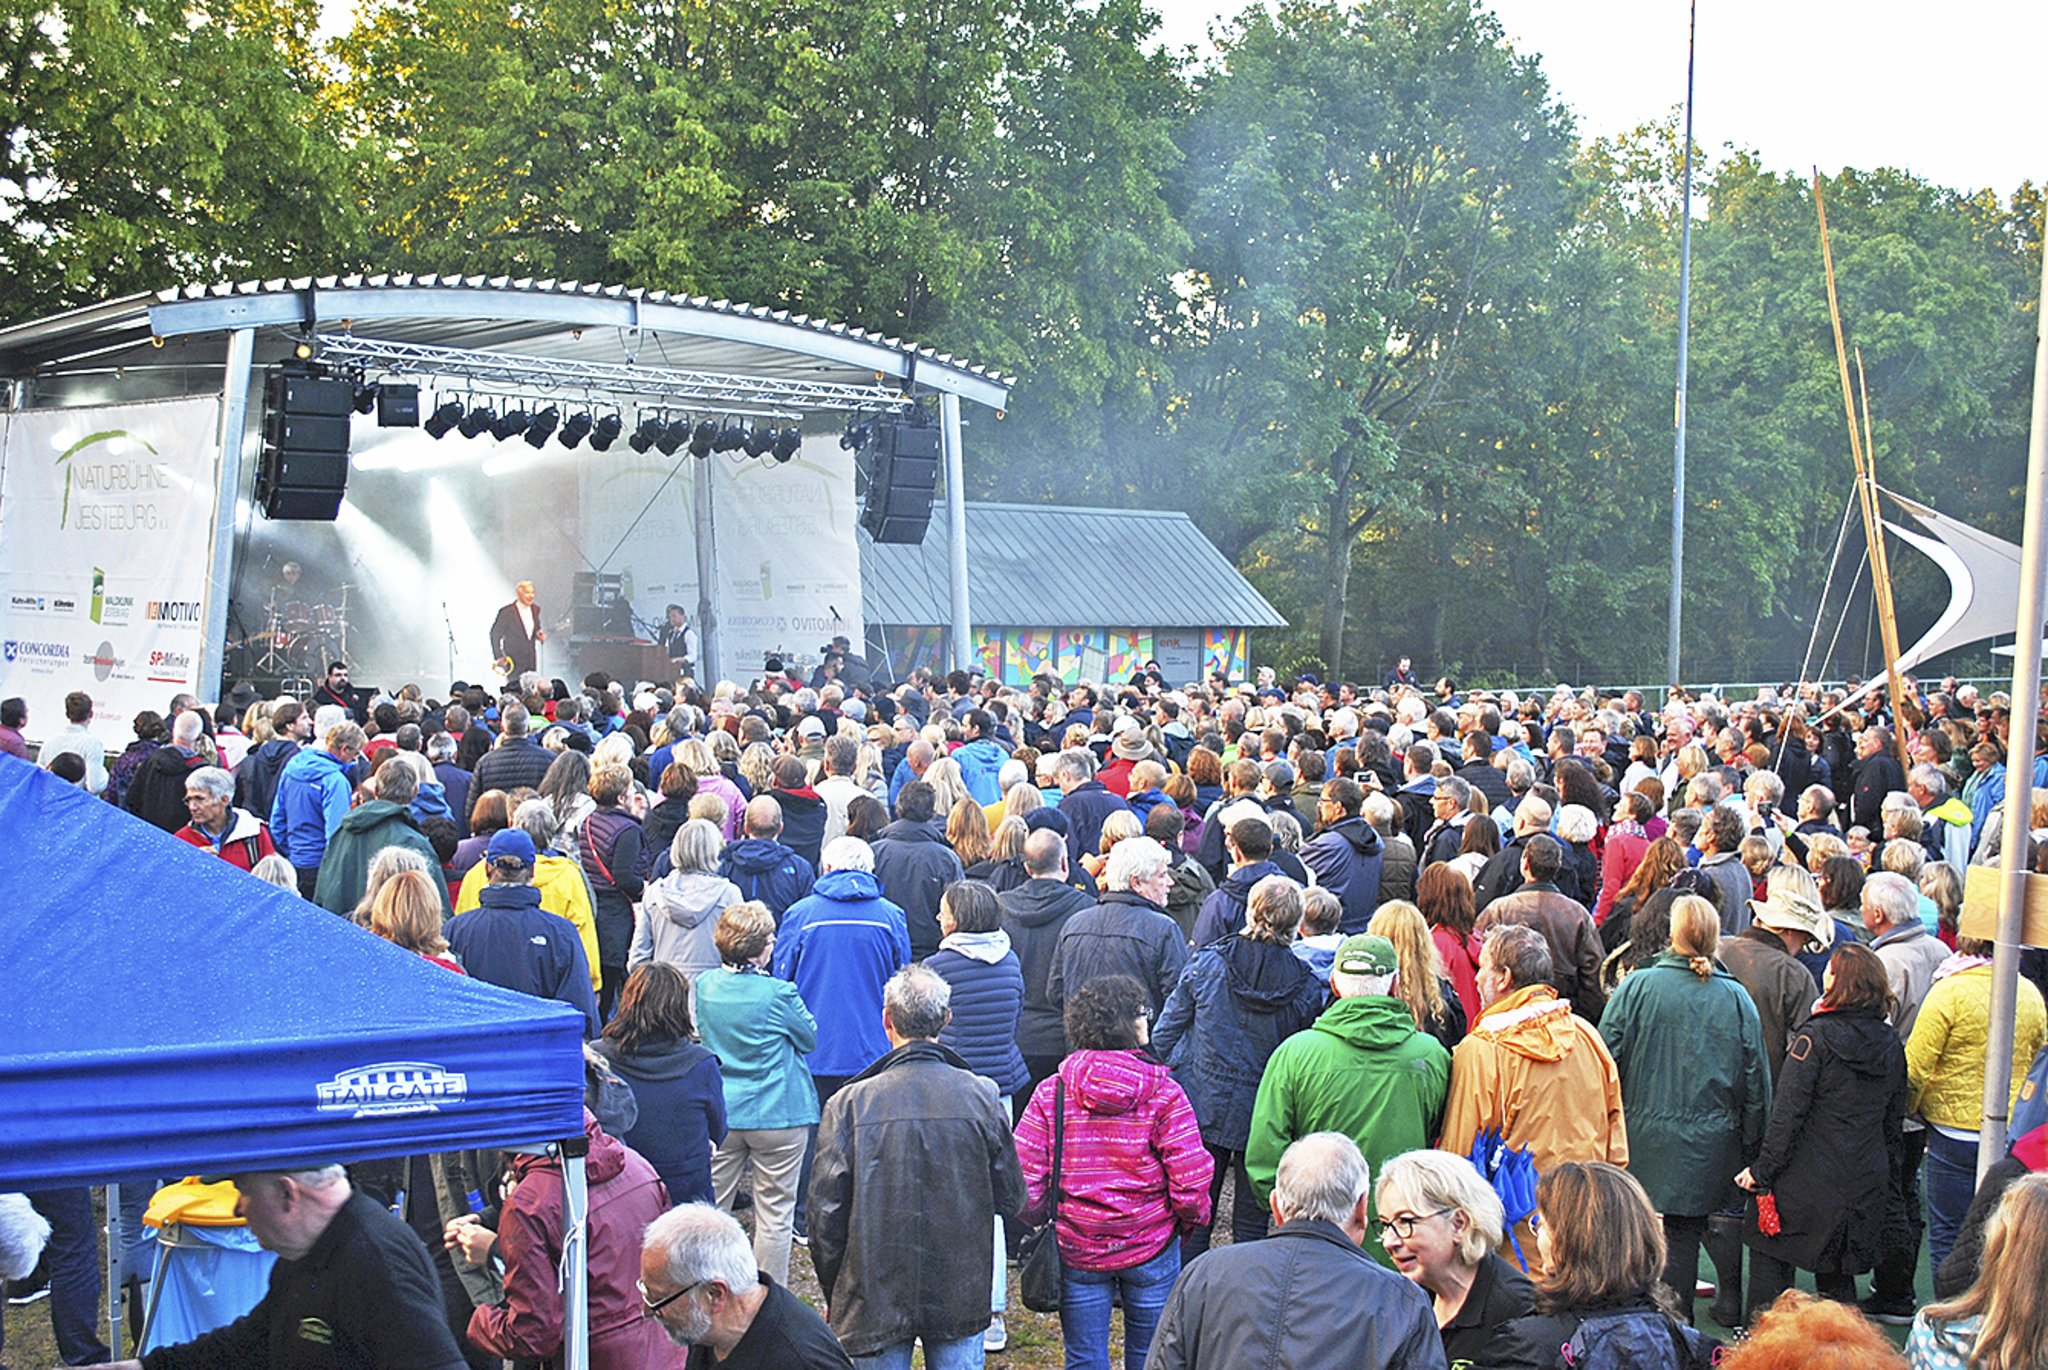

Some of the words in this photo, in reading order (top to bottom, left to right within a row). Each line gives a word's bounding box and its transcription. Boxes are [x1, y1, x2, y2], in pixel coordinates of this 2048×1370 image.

[74, 504, 157, 531] JESTEBURG
[19, 641, 70, 658] CONCORDIA
[325, 1080, 458, 1104] TAILGATE
